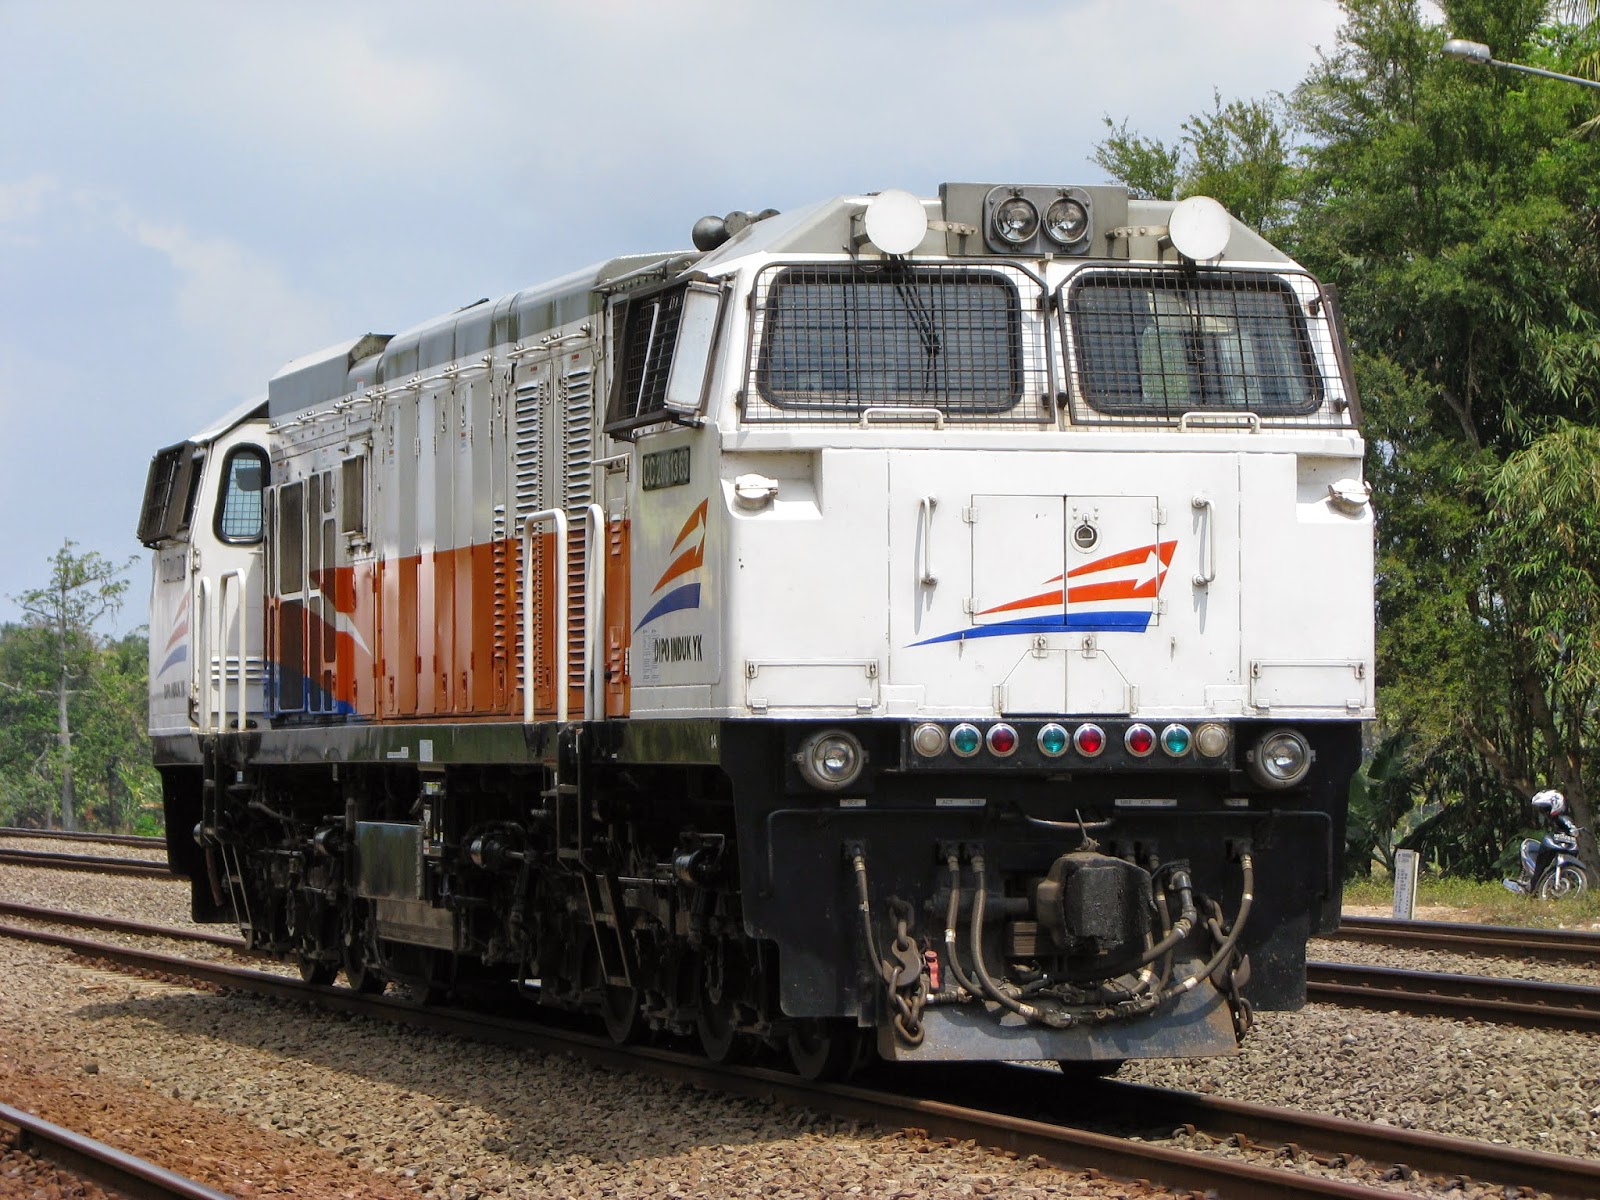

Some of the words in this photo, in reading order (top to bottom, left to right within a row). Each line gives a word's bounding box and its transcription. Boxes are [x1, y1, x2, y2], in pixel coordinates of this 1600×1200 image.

[654, 637, 670, 663] DIPO
[670, 635, 692, 663] INDUK
[692, 634, 703, 662] YK
